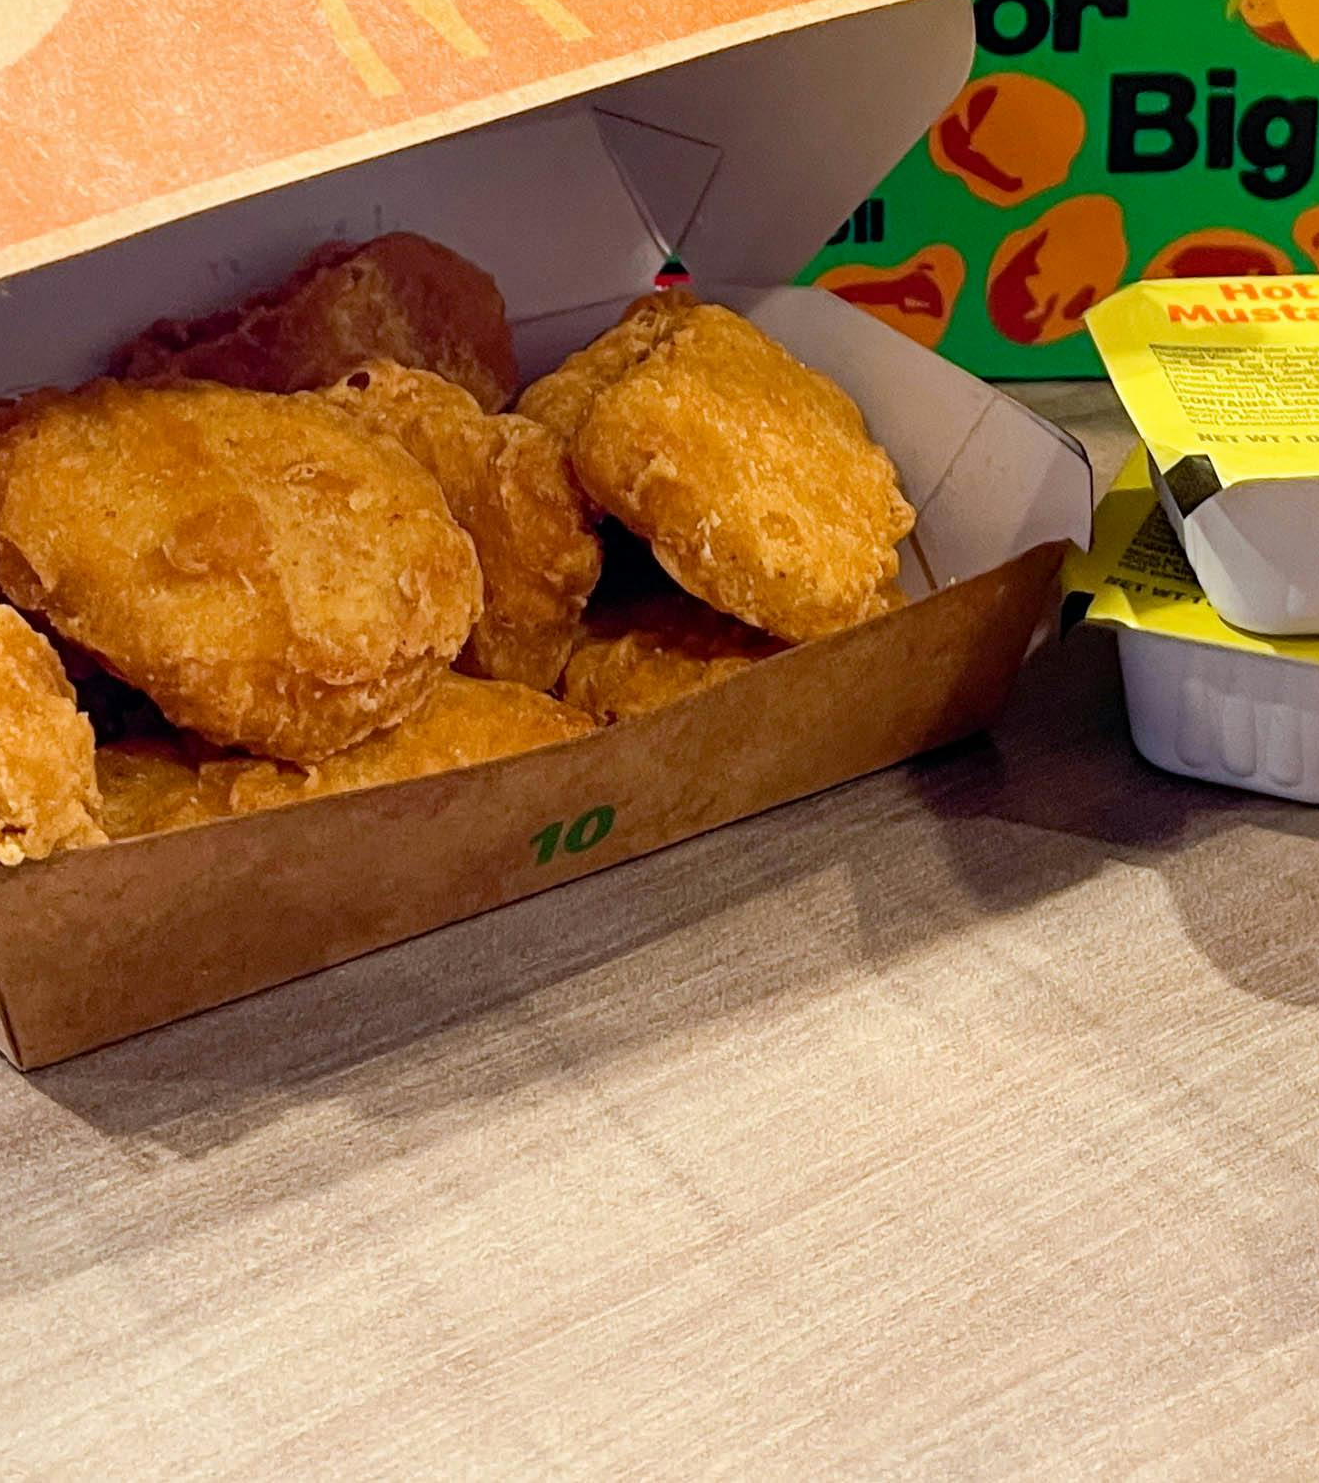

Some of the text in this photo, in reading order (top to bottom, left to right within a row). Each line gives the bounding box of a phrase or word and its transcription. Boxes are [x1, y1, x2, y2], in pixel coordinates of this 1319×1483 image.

[1106, 67, 1319, 201] Big
[1197, 432, 1239, 443] NET
[1245, 433, 1282, 443] WT
[530, 804, 616, 865] 10
